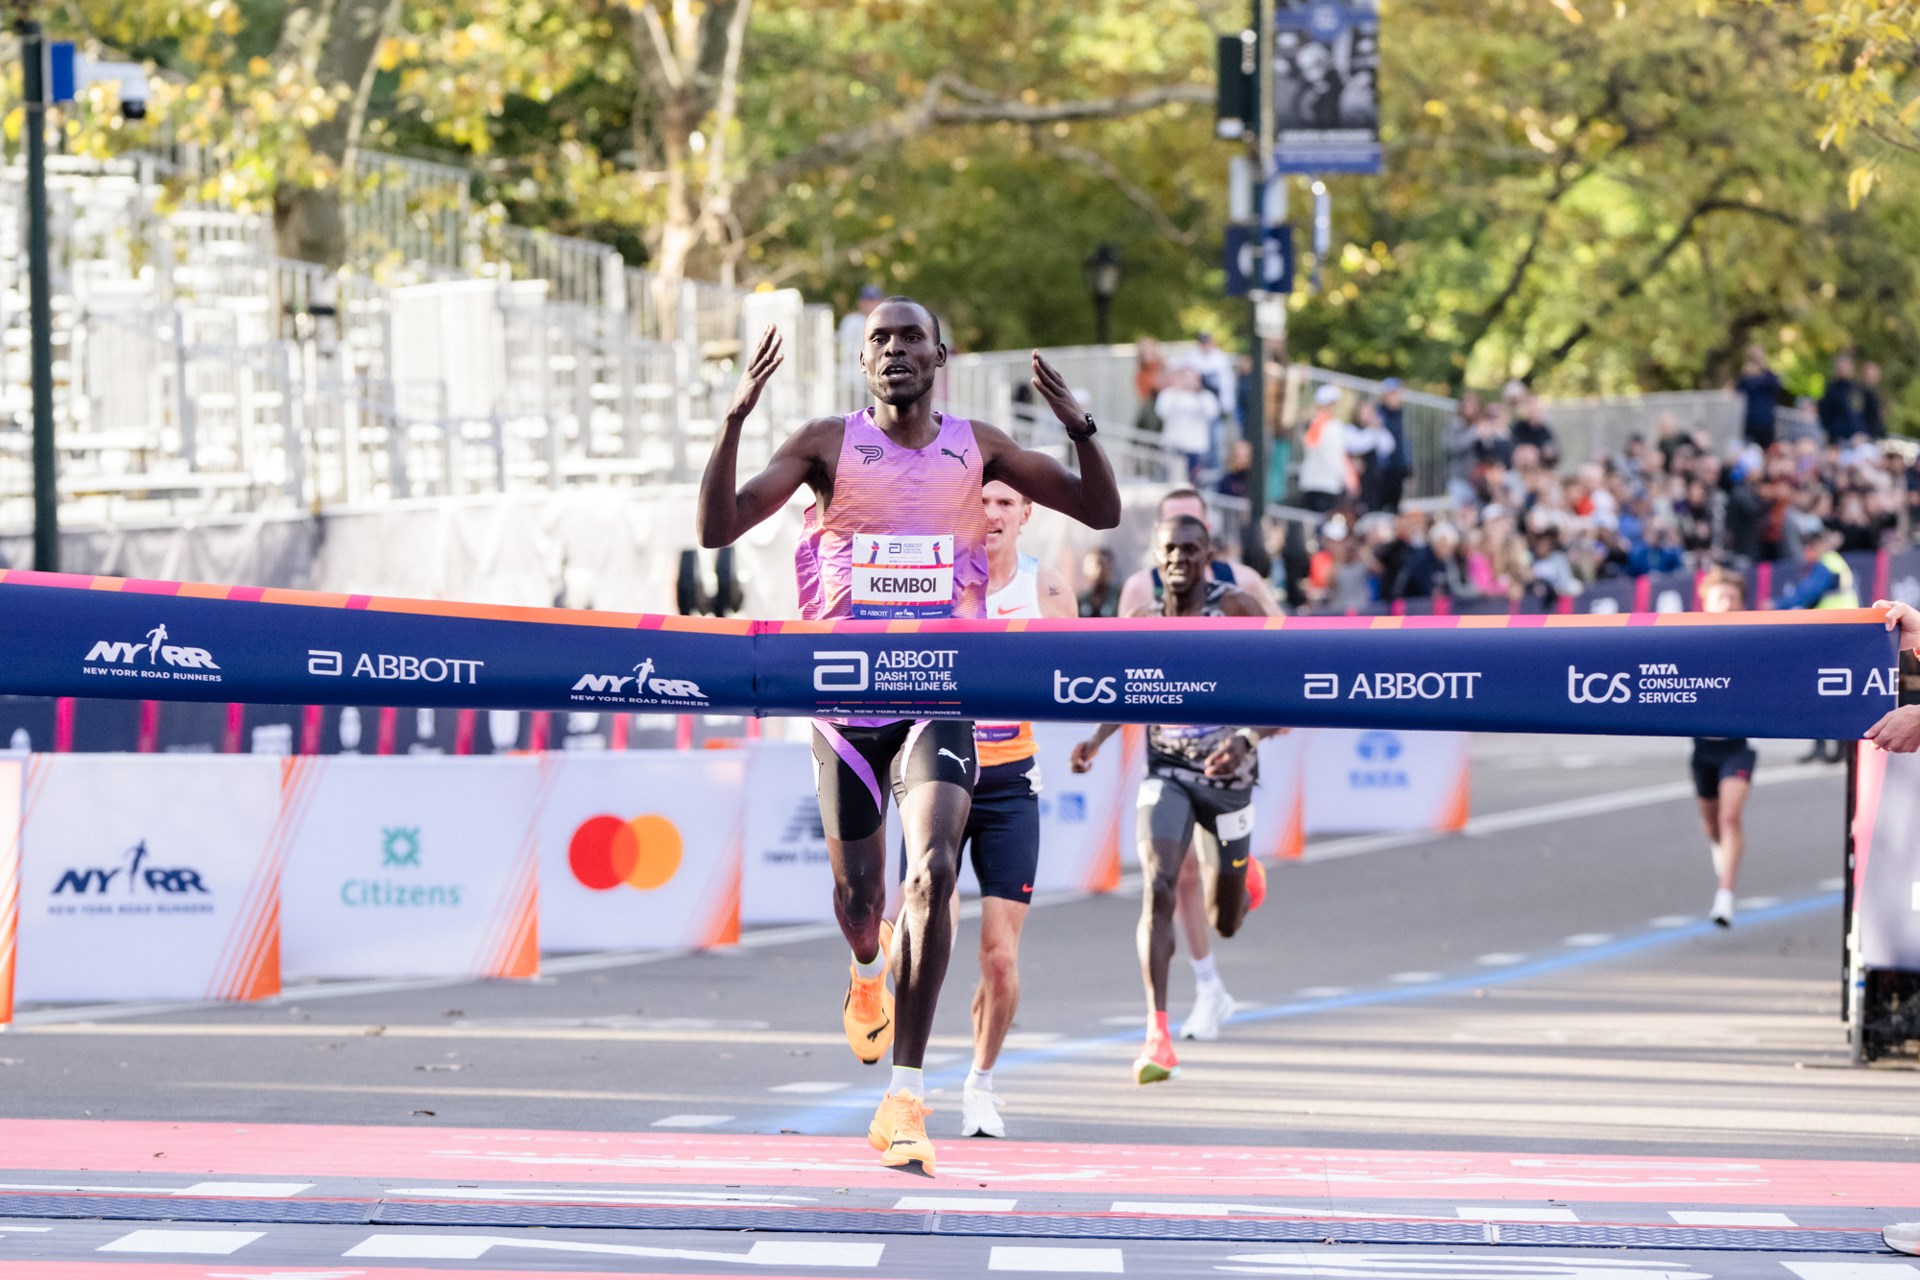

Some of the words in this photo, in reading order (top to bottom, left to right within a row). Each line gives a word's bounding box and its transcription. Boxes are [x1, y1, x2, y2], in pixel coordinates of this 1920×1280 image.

[870, 577, 937, 593] KEMBOI
[874, 650, 958, 668] ABBOTT
[83, 667, 108, 675] NEW
[110, 669, 138, 677] YORK
[141, 671, 170, 679] ROAD
[173, 673, 222, 682] RUNNERS
[352, 653, 484, 684] ABBOTT
[1124, 669, 1165, 679] TATA
[1638, 664, 1678, 675] TATA
[875, 671, 907, 681] DASH
[909, 671, 926, 681] TO
[928, 671, 951, 681] THE
[875, 682, 913, 691] FINISH
[915, 682, 940, 691] LINE
[942, 682, 957, 691] 5K
[1053, 669, 1117, 704] tcs
[1124, 682, 1217, 693] CONSULTANCY
[1348, 672, 1482, 699] ABBOTT
[1568, 665, 1631, 704] tcs
[1638, 677, 1731, 689] CONSULTANCY
[661, 699, 710, 707] RUNNERS
[1124, 694, 1183, 704] SERVICES
[1638, 692, 1697, 703] SERVICES
[340, 877, 461, 908] Citizens
